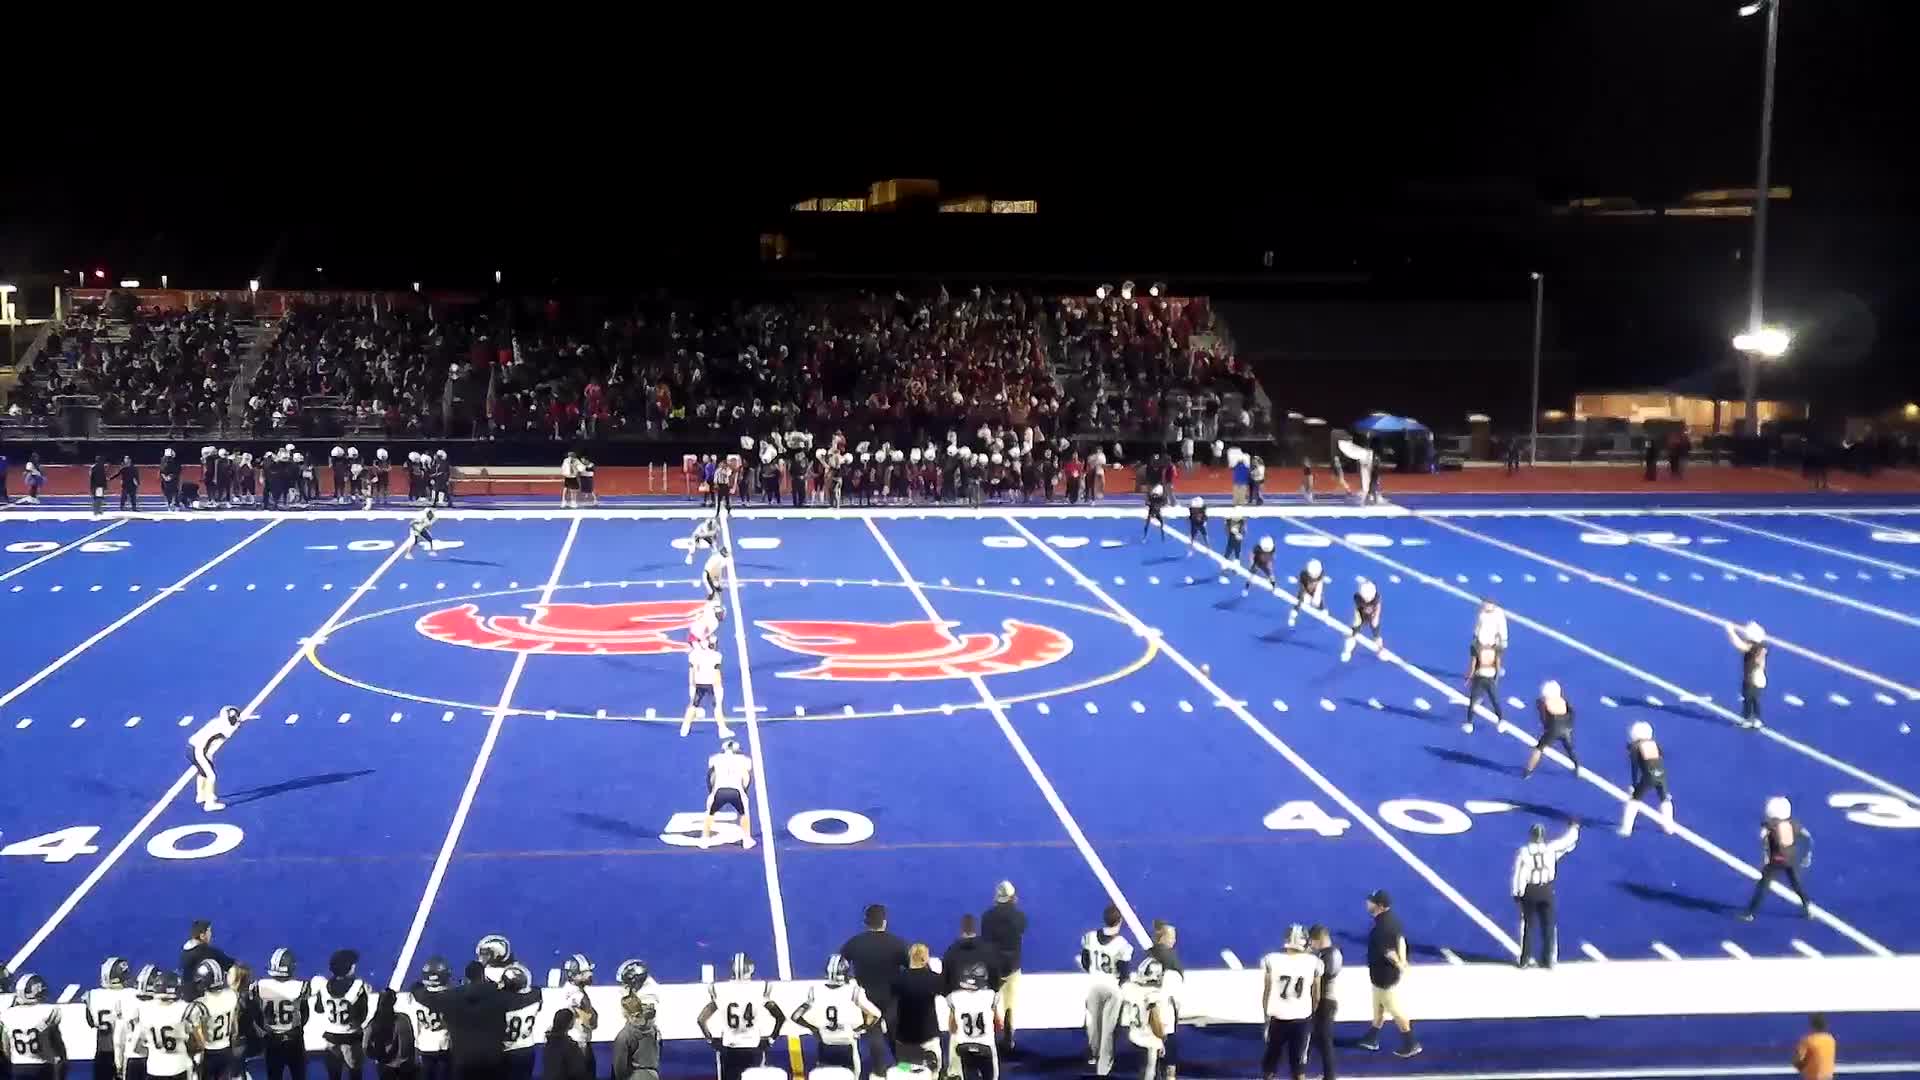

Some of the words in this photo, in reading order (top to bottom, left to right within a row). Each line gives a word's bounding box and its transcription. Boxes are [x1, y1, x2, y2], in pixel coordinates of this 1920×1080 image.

[213, 1011, 231, 1040] 21
[727, 1002, 754, 1029] 64
[825, 1005, 839, 1031] 9
[150, 1025, 176, 1051] 16
